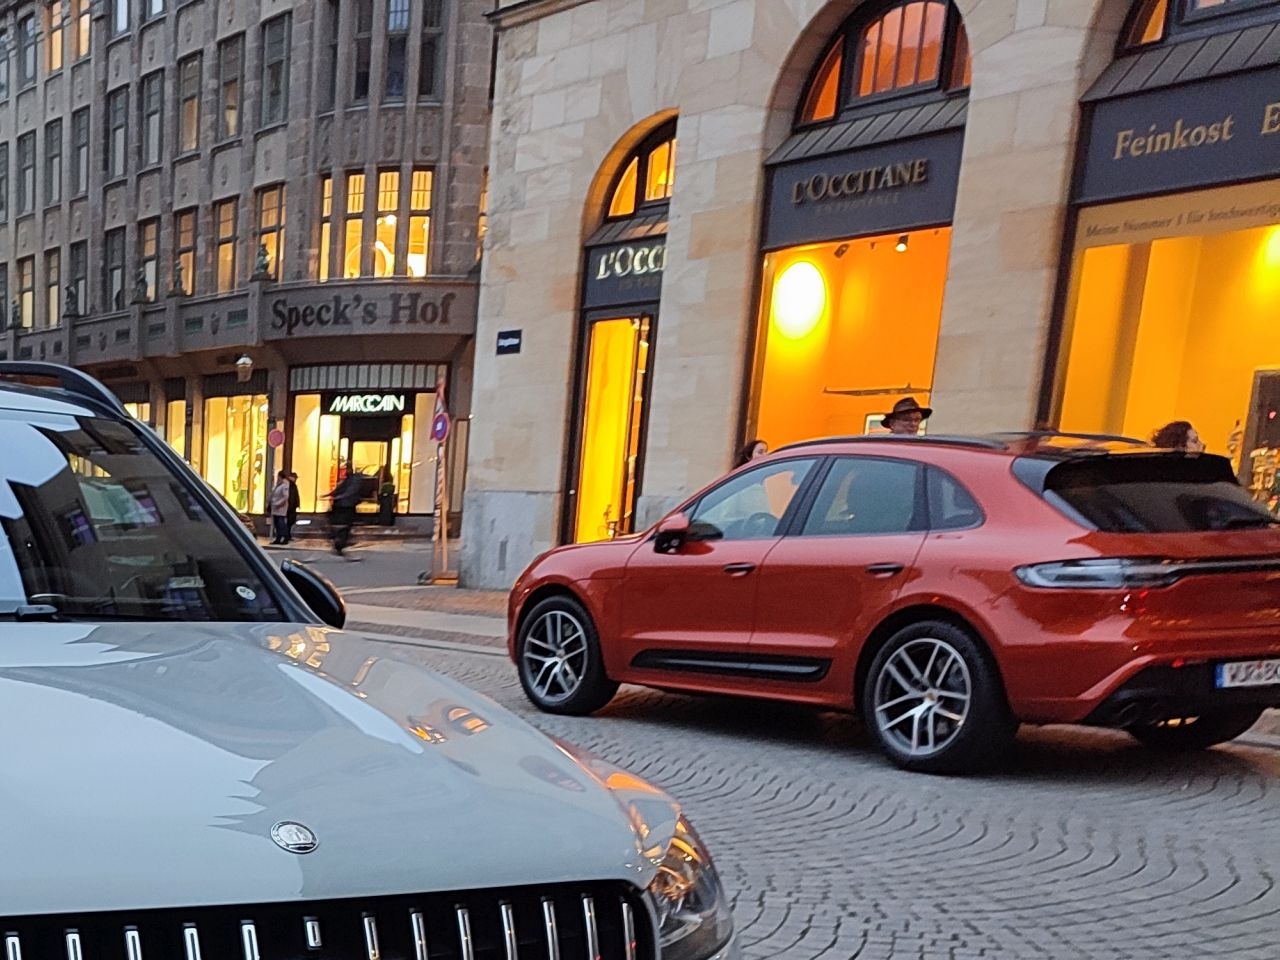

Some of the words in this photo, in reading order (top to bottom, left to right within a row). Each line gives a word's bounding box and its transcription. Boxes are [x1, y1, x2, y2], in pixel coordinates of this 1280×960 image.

[1113, 114, 1234, 160] Feinkost
[791, 157, 928, 204] L'OCCITANE
[271, 294, 378, 336] Speck's
[388, 291, 457, 325] Hof
